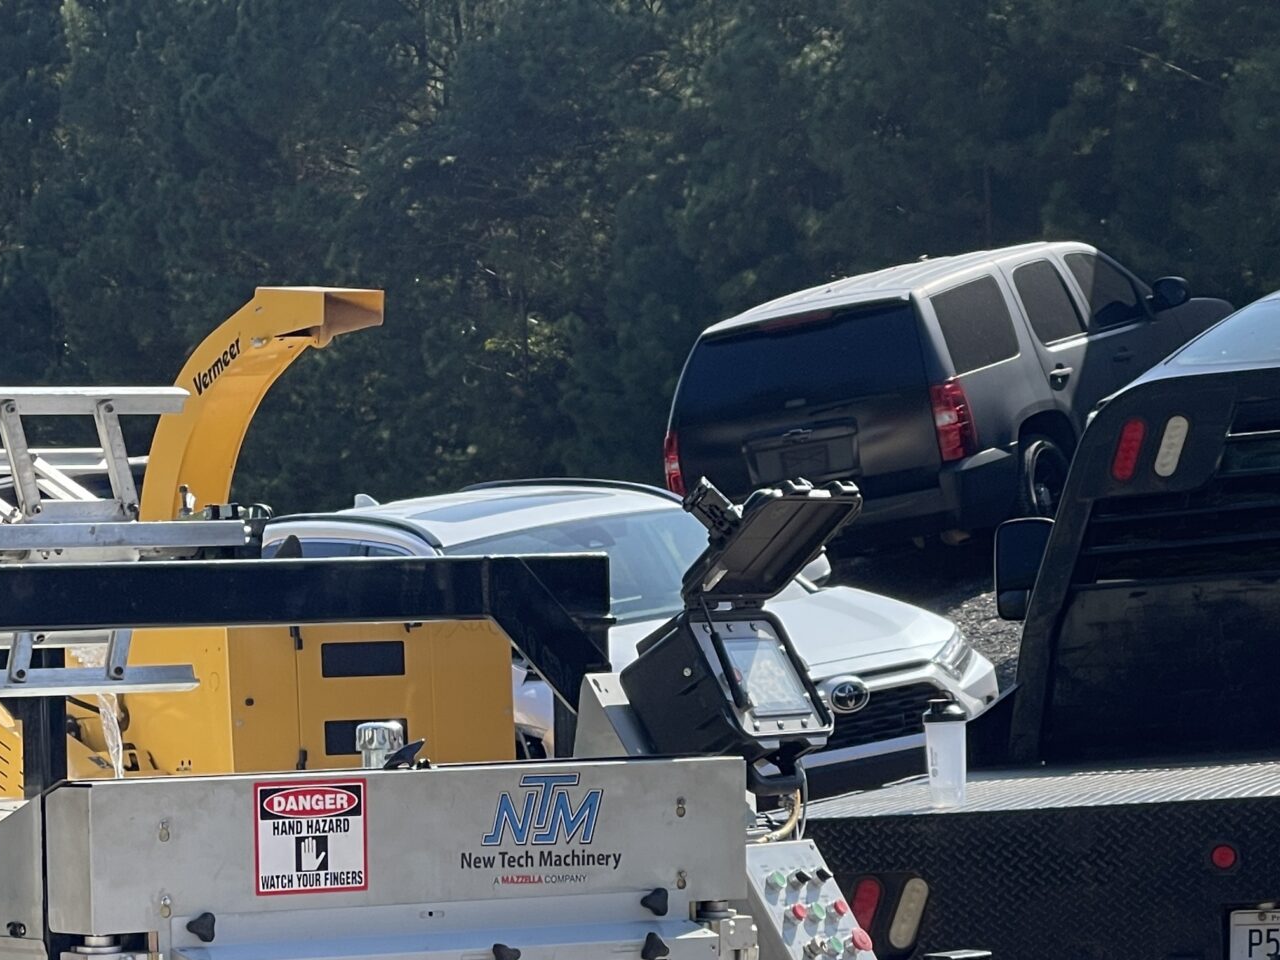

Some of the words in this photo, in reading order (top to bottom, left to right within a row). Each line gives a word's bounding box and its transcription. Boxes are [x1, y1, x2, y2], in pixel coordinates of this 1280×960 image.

[192, 337, 241, 396] Vermeer
[273, 793, 349, 812] DANGER
[481, 772, 604, 846] NTM
[272, 820, 303, 836] HAND
[306, 818, 350, 835] HAZARD
[460, 852, 496, 869] New
[499, 850, 534, 868] Tech
[539, 849, 622, 870] Machinery
[261, 874, 294, 890] WATCH
[296, 873, 321, 888] YOUR
[324, 871, 363, 887] FINGERS
[501, 875, 543, 884] MAZZELLA
[544, 874, 587, 884] COMPANY
